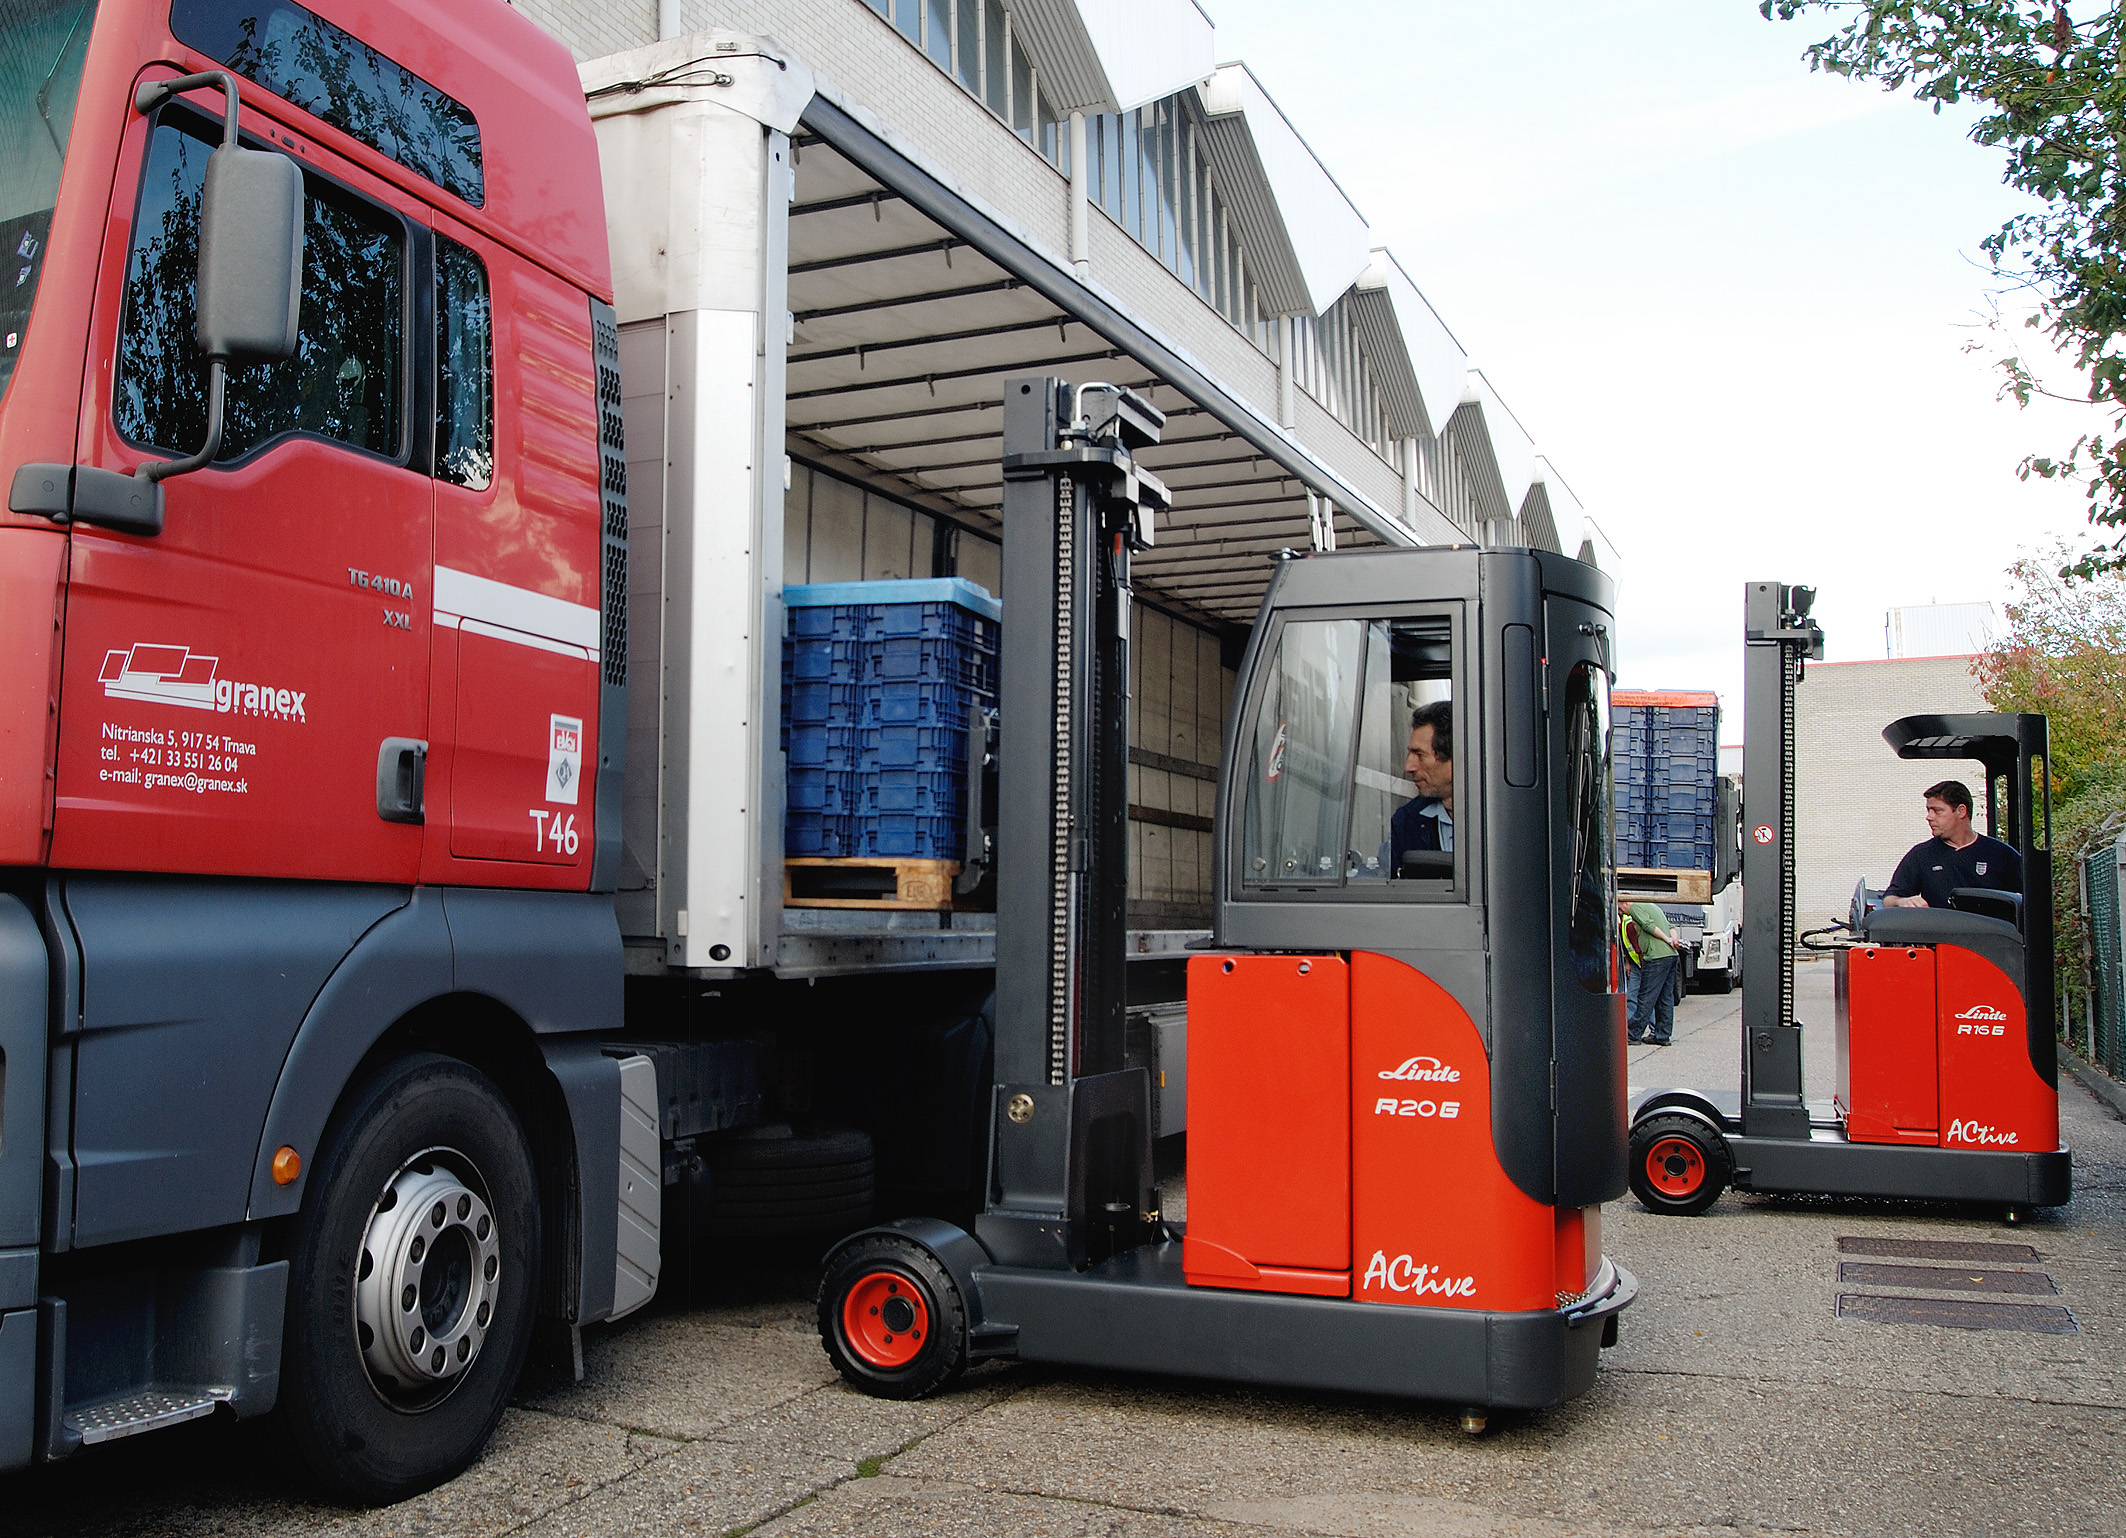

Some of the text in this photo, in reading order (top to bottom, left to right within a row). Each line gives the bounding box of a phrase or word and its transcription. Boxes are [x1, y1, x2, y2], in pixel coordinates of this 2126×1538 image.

[348, 567, 413, 600] TG 410 A
[383, 609, 412, 631] XXL
[216, 679, 306, 716] granex
[234, 706, 306, 723] SLOVAKIA
[102, 722, 256, 755] Nitrianska 5, 917 54 Trnava
[101, 745, 238, 772] tel. +421 33 551 26 04
[100, 767, 248, 794] e-mail: granex@granex.sk
[529, 809, 579, 855] T46
[1954, 1005, 2007, 1021] Linde
[1957, 1024, 1989, 1035] R16
[1378, 1056, 1460, 1082] Linde
[1374, 1098, 1437, 1117] R20
[1947, 1118, 2019, 1145] ACtive
[1363, 1250, 1477, 1297] ACtive
